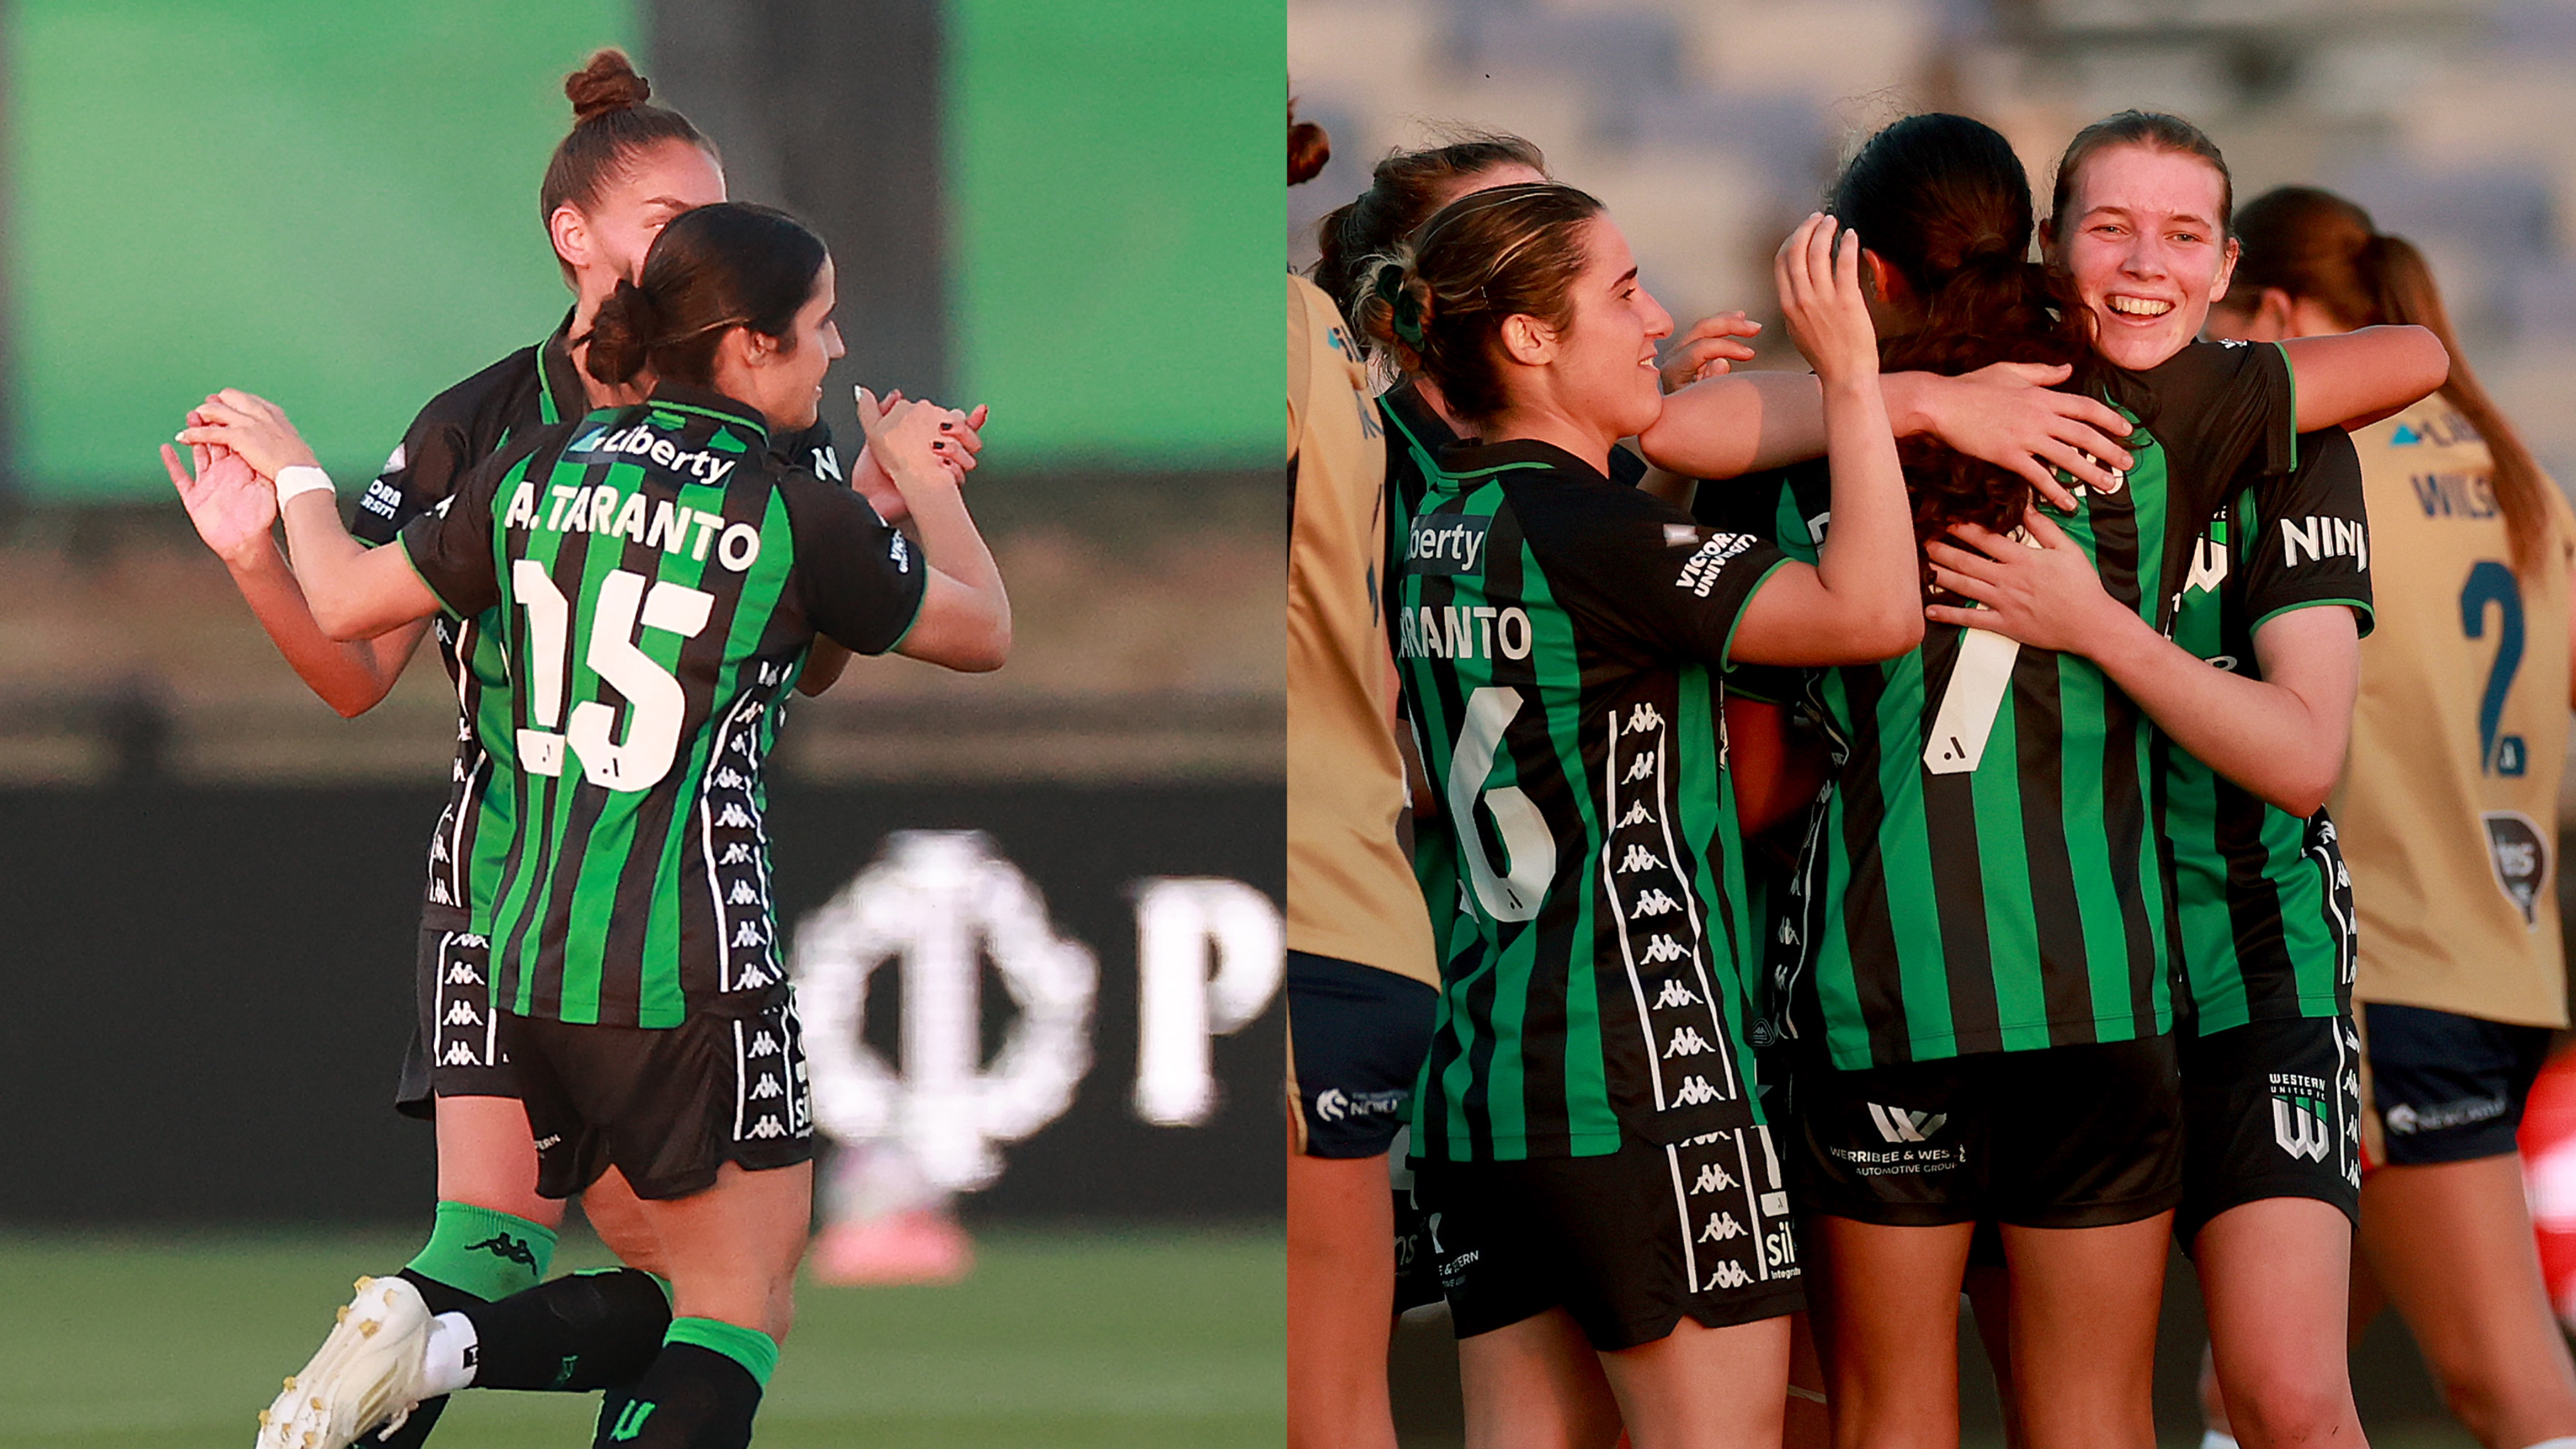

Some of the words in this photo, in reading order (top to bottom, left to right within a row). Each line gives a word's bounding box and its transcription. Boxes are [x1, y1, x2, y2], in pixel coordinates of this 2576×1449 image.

[602, 425, 736, 485] Liberty
[513, 559, 715, 792] 15
[2461, 561, 2526, 777] 2
[1404, 682, 1557, 923] 6
[2269, 1073, 2326, 1091] WESTERN
[1829, 1146, 1899, 1163] WERRIBEE
[1903, 1151, 1914, 1160] &
[1856, 1163, 1921, 1177] AUTOMOTIVE
